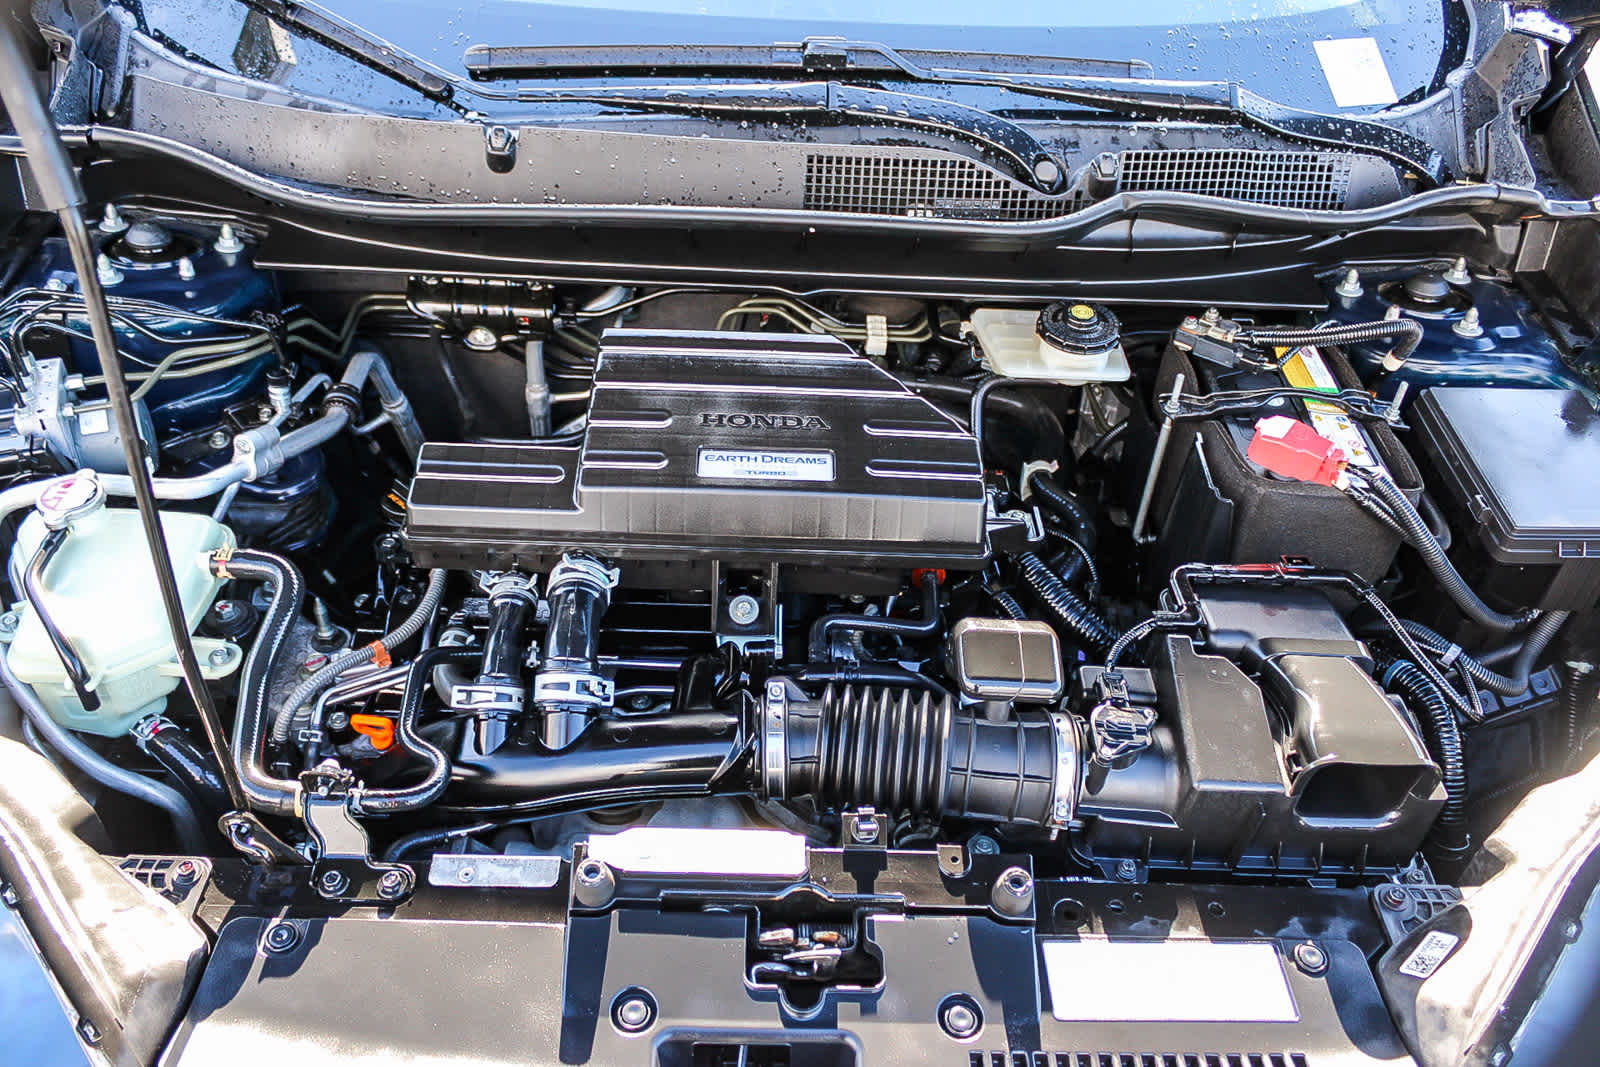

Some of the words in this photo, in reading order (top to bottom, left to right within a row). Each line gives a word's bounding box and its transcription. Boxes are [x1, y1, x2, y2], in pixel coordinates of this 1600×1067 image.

[700, 413, 831, 430] HONDA
[704, 454, 758, 464] EARTH
[761, 455, 828, 465] DREAMS
